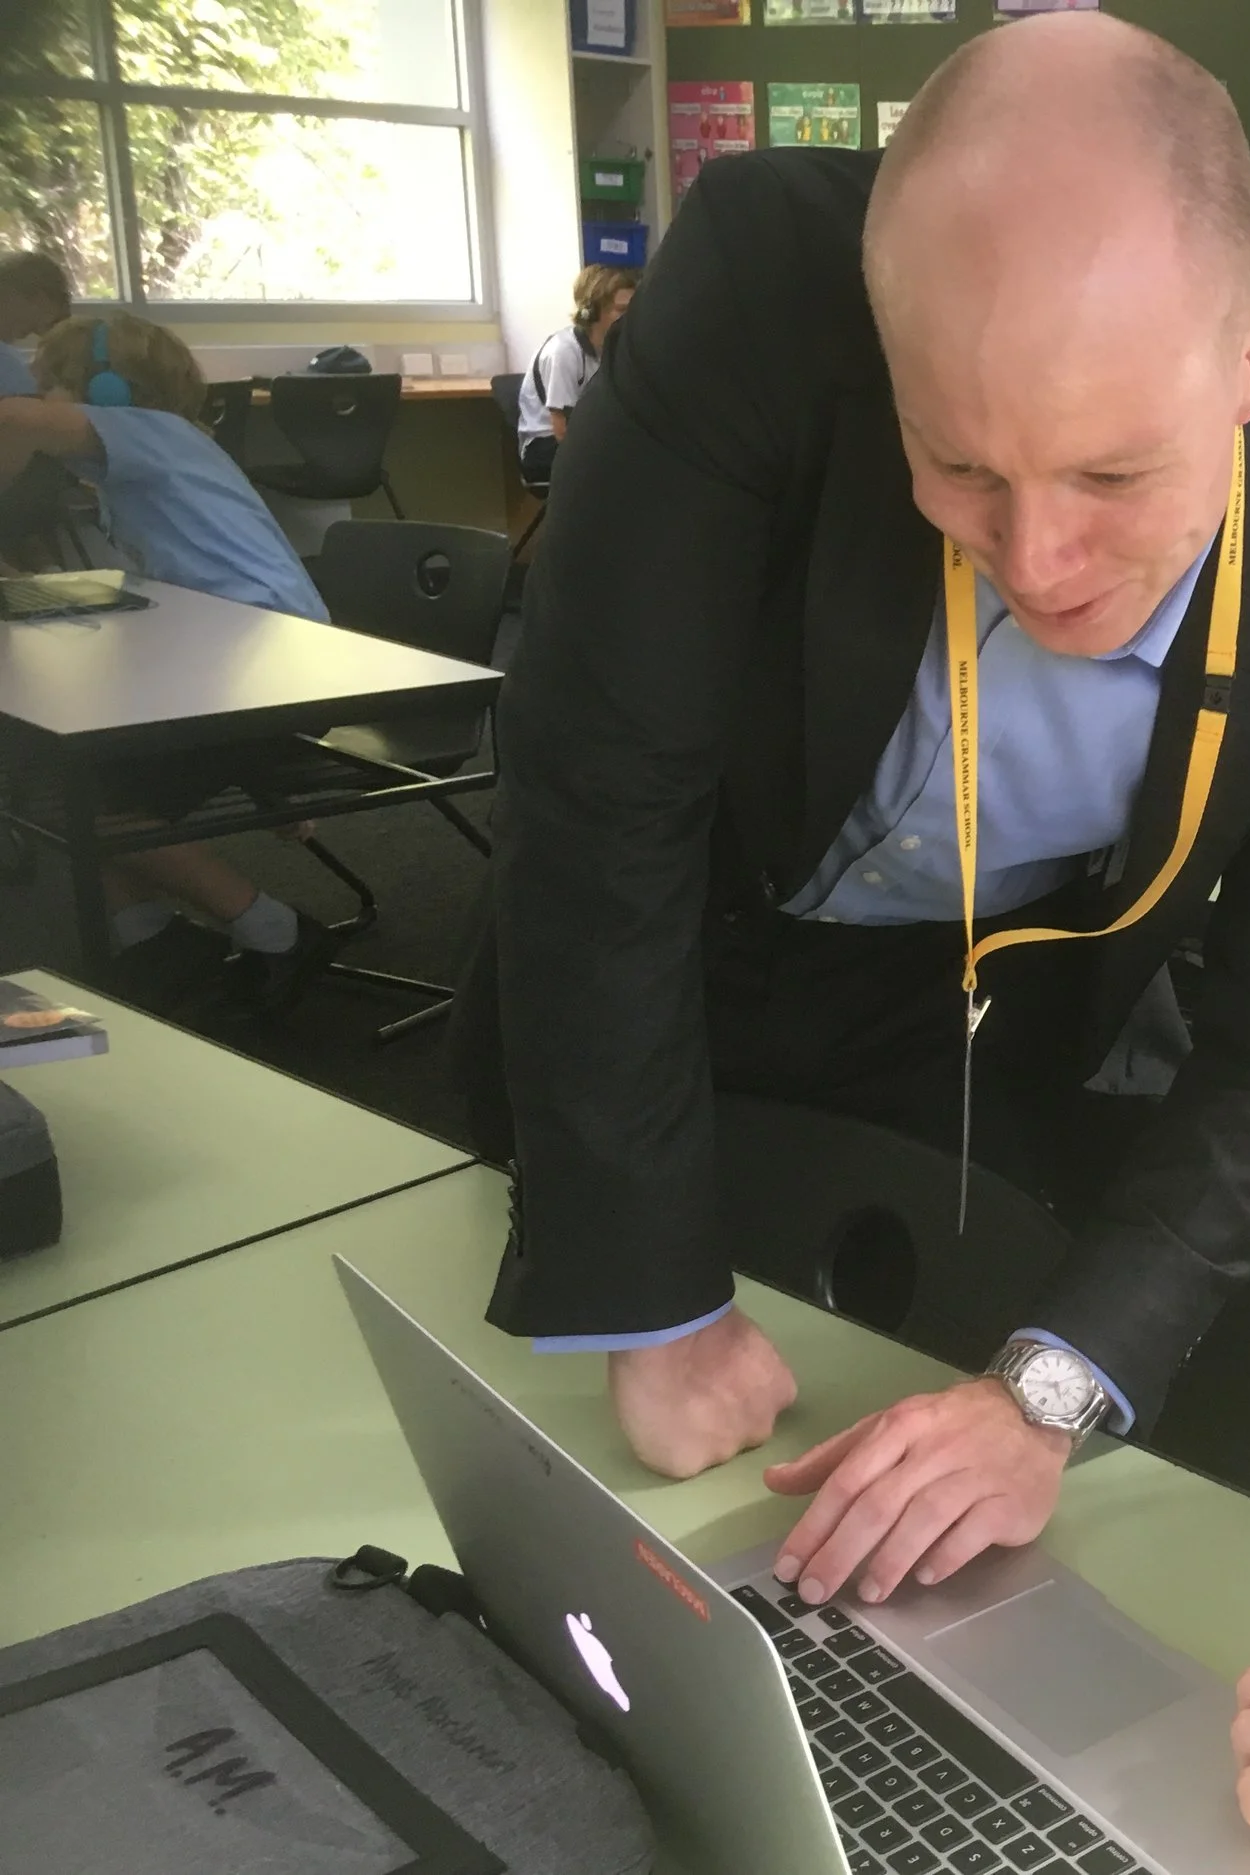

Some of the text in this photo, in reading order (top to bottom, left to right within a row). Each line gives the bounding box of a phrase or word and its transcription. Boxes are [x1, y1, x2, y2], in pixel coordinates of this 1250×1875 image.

[1229, 491, 1242, 566] MELBOURNE
[958, 660, 973, 851] MELBOURNE GRAMMAR SCHOOL
[858, 1700, 872, 1711] M
[810, 1707, 821, 1717] K
[883, 1722, 897, 1733] N
[910, 1747, 922, 1756] B
[858, 1753, 873, 1763] H
[936, 1771, 948, 1780] V
[826, 1779, 838, 1788] Y
[885, 1777, 898, 1787] G
[963, 1794, 976, 1803] C
[852, 1803, 864, 1812] T
[912, 1803, 924, 1811] F
[992, 1818, 1006, 1829] X
[880, 1829, 892, 1838] R
[940, 1827, 953, 1837] D
[1021, 1844, 1036, 1854] Z
[907, 1854, 920, 1864] E
[969, 1853, 981, 1862] S
